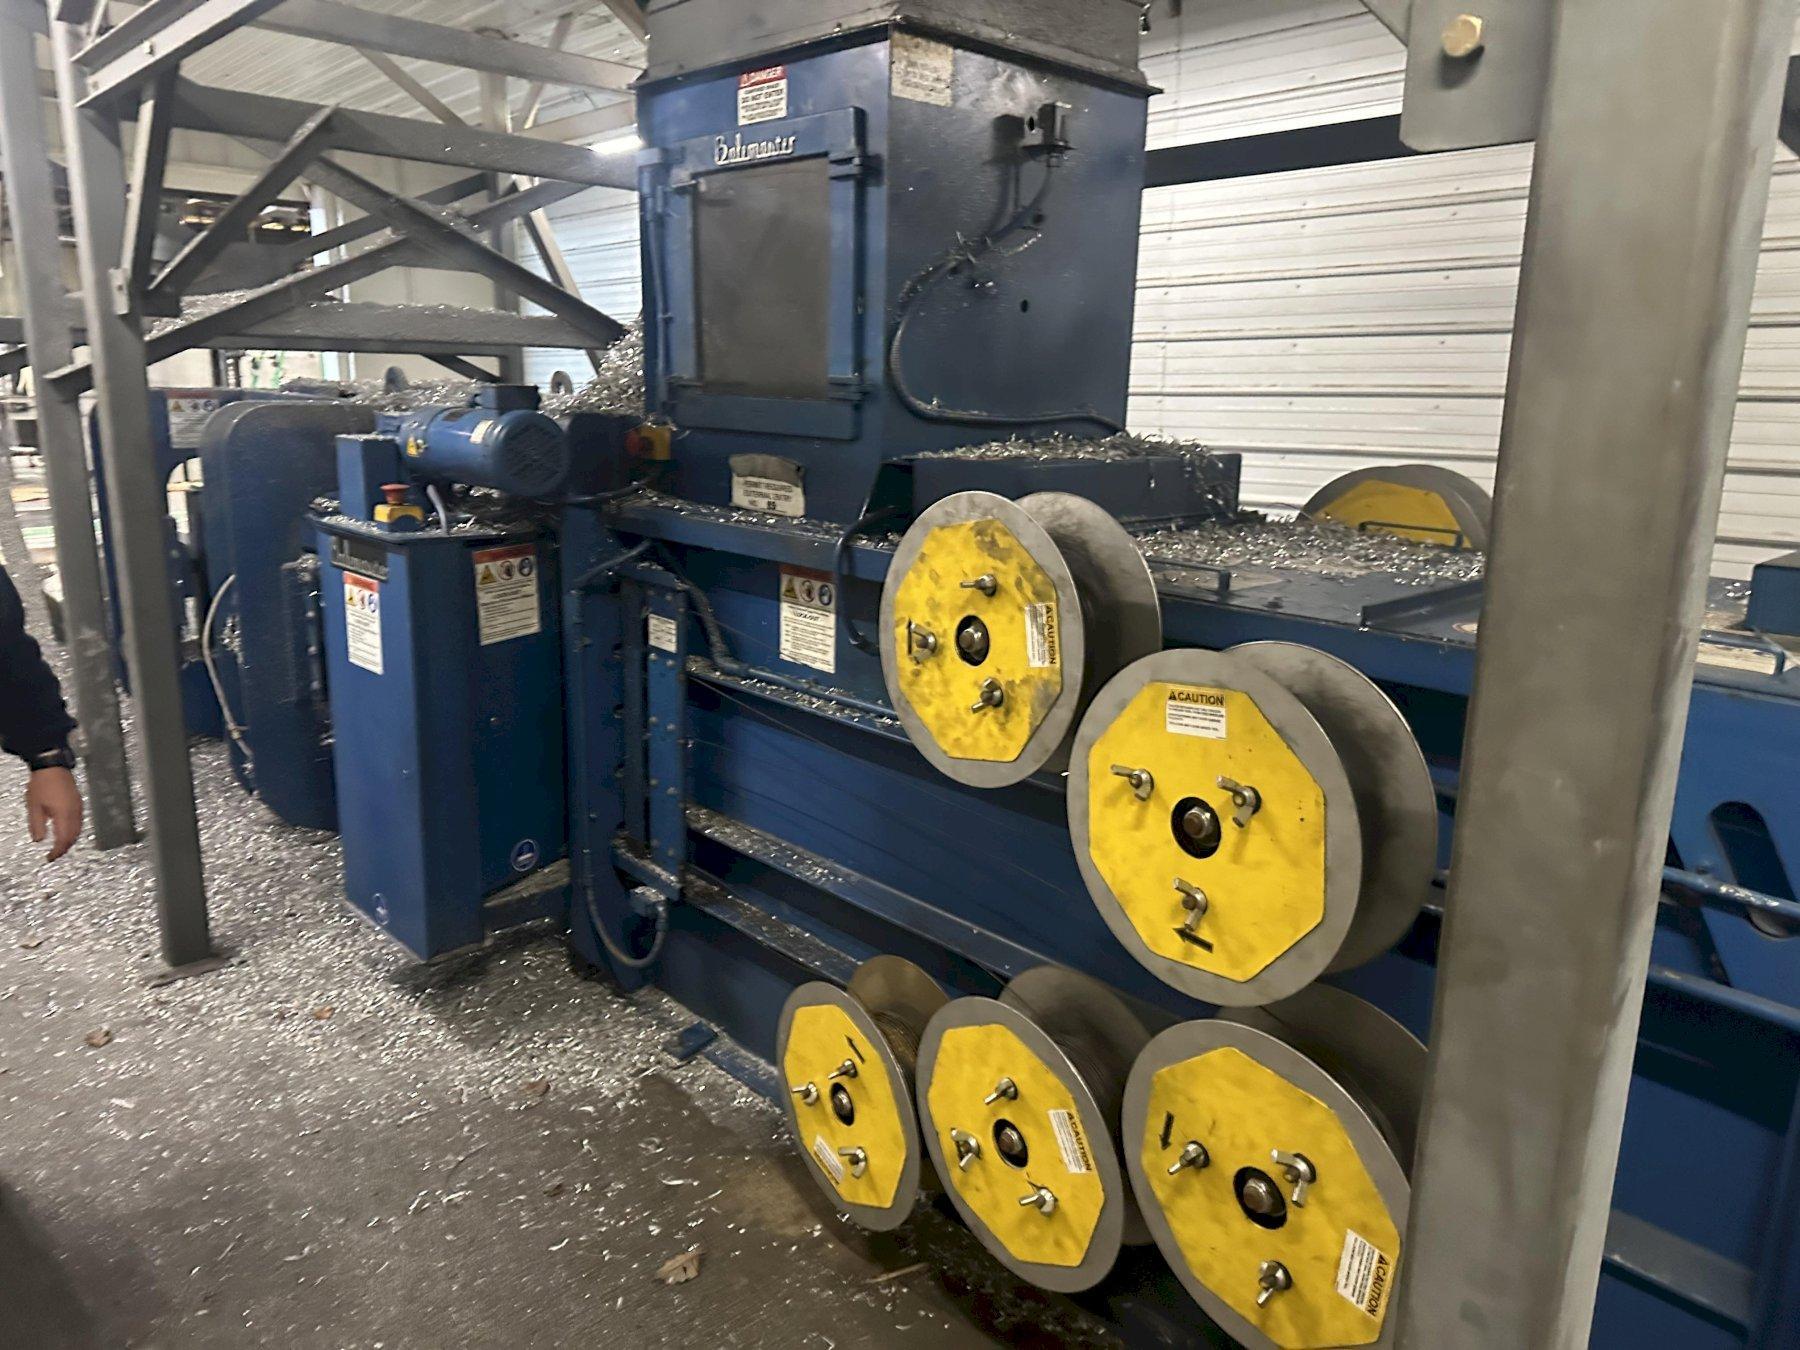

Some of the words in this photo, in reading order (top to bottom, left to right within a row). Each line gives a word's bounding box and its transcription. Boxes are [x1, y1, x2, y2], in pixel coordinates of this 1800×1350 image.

[1047, 615, 1057, 665] CAUTION
[1177, 692, 1224, 706] CAUTION
[1071, 1121, 1092, 1171] CAUTION
[1367, 1266, 1386, 1317] CAUTION
